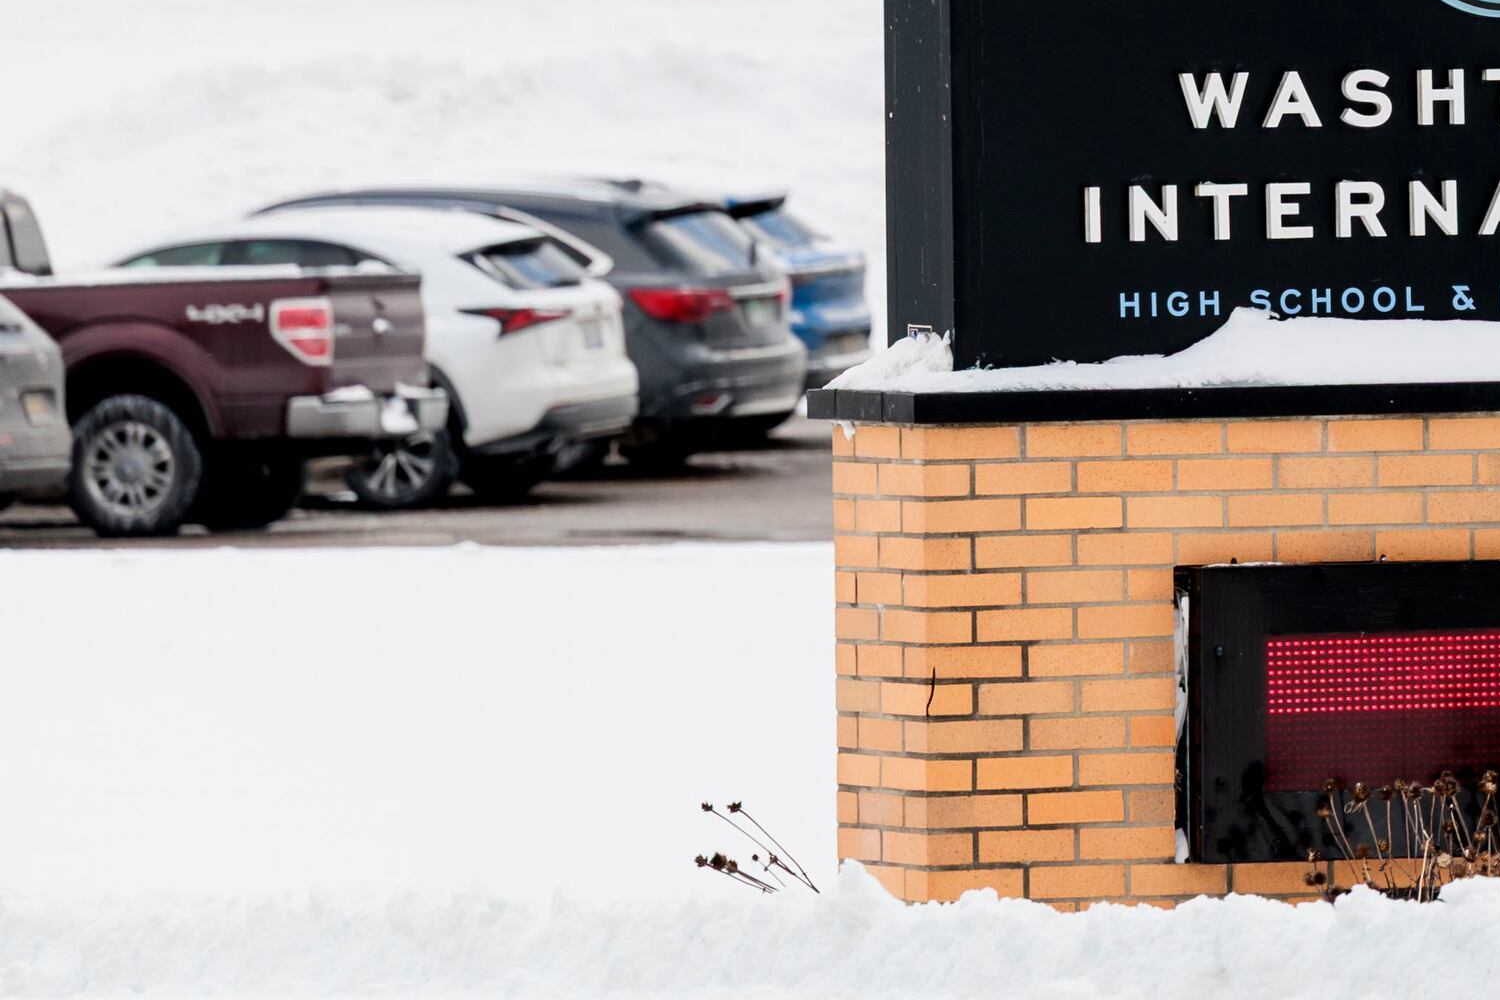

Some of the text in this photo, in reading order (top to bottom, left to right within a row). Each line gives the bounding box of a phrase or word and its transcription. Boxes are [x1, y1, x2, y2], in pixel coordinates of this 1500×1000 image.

[1119, 291, 1220, 318] HIGH
[1250, 286, 1425, 315] SCHOOL
[1452, 285, 1477, 312] &
